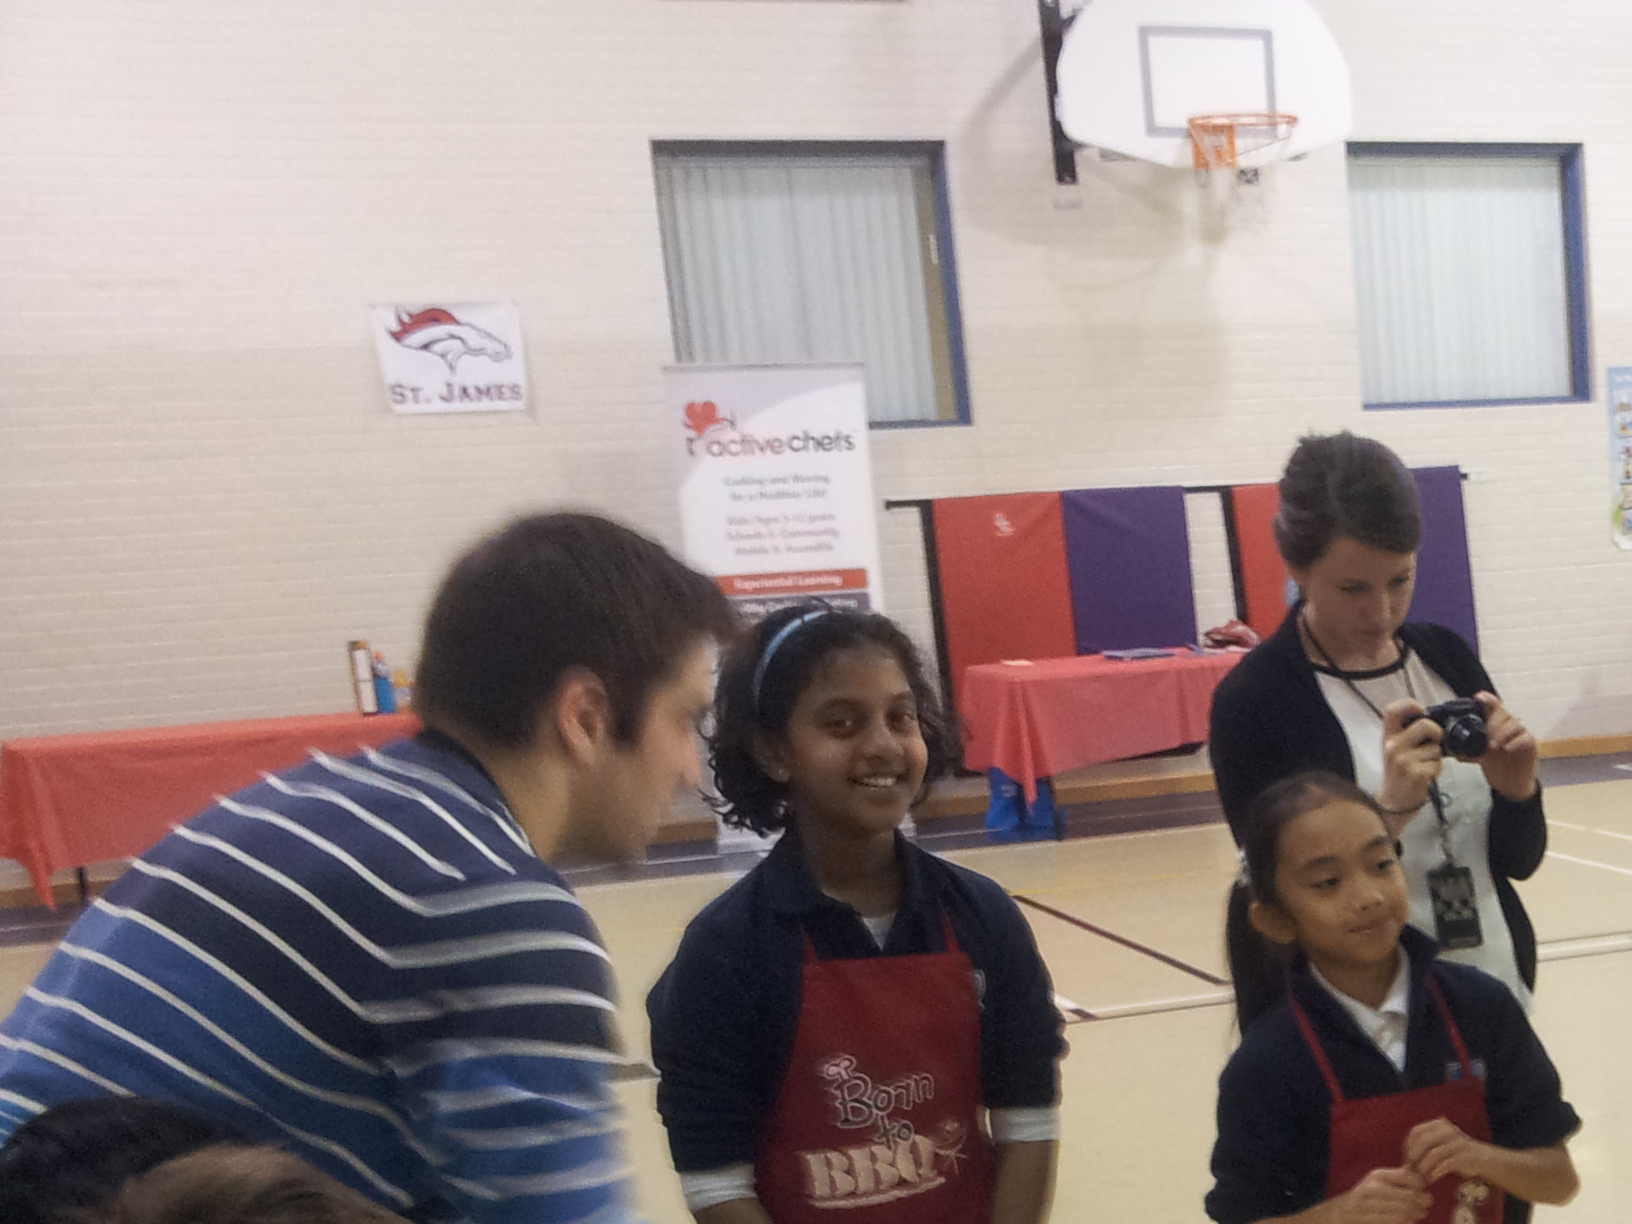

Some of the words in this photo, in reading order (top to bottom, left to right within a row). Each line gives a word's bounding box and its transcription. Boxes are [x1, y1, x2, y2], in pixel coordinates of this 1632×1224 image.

[439, 382, 523, 403] JAMES
[830, 1073, 935, 1130] Born
[873, 1114, 914, 1151] to
